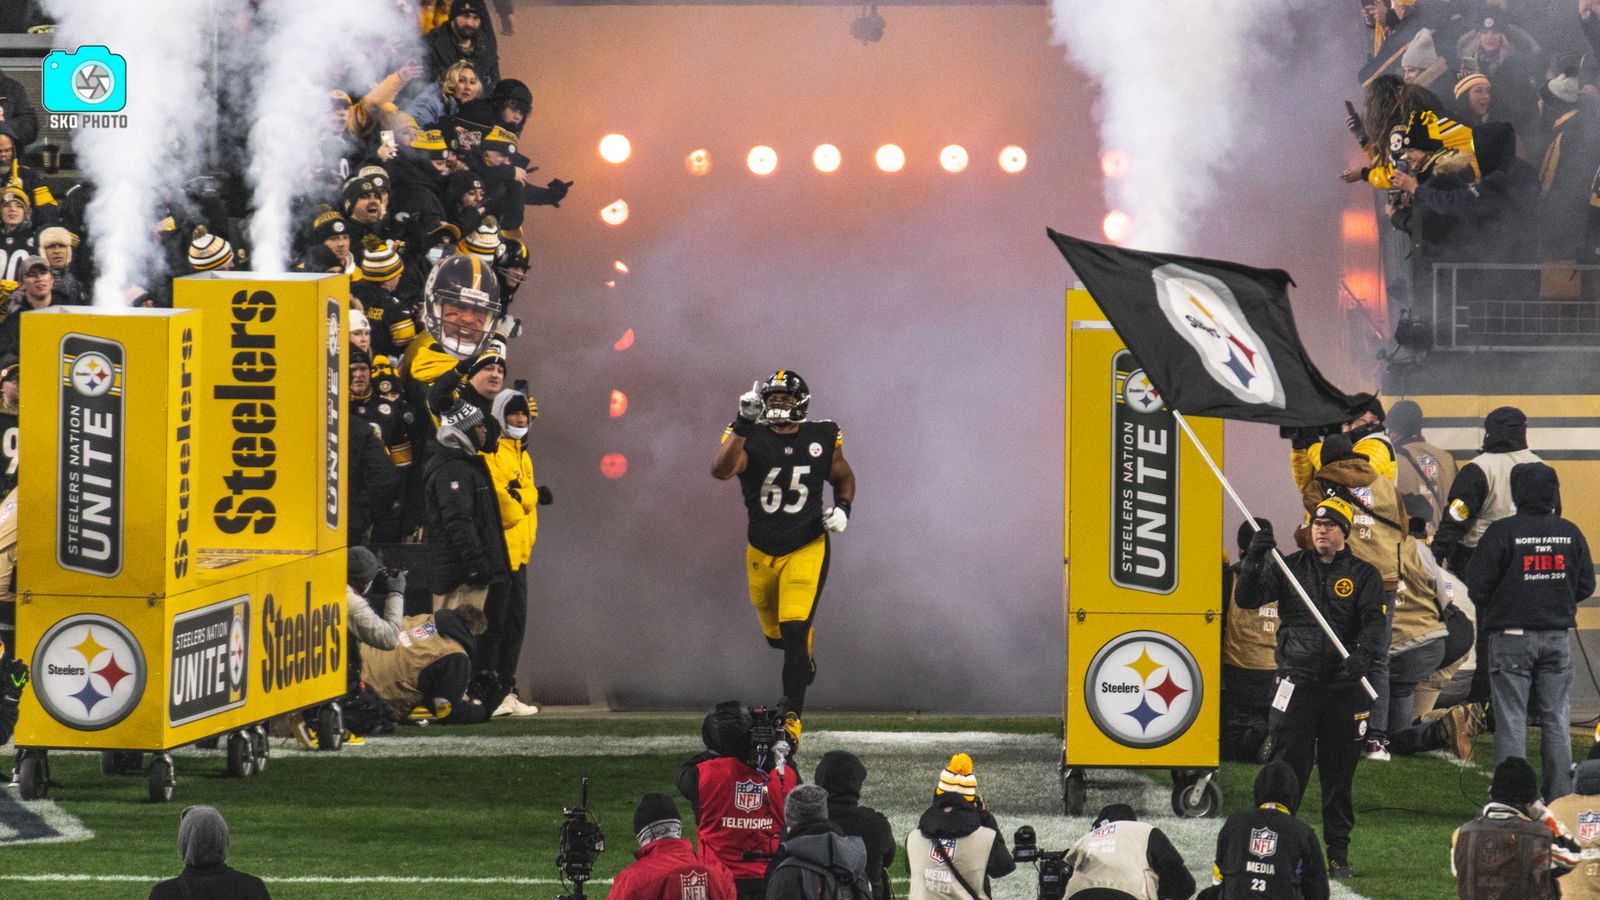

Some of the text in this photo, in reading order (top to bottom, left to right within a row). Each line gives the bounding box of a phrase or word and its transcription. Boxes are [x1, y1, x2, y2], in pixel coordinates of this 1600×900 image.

[214, 290, 277, 535] Steelers
[327, 370, 339, 516] UNITE
[174, 328, 193, 579] Steelers
[68, 405, 80, 555] STEELERS NATION
[81, 408, 113, 561] UNITE
[760, 465, 811, 514] 65
[1122, 422, 1134, 573] STEELERS NATION
[1136, 425, 1168, 578] UNITE
[1359, 528, 1372, 539] 94
[1515, 536, 1572, 545] NORTH FAYETTE
[1523, 554, 1566, 571] FIRE
[175, 621, 229, 650] STEELERS NATION
[262, 581, 341, 694] Steelers
[48, 664, 86, 676] Steelers
[173, 643, 228, 706] UNITE
[1101, 682, 1140, 694] Steelers
[738, 793, 760, 809] NFL
[721, 817, 773, 830] TELEVISION
[1580, 823, 1599, 838] NFL
[1253, 840, 1274, 854] NFL
[924, 868, 952, 883] MEDIA
[1246, 861, 1275, 875] MEDIA
[684, 886, 706, 900] NFL
[1251, 878, 1267, 892] 23
